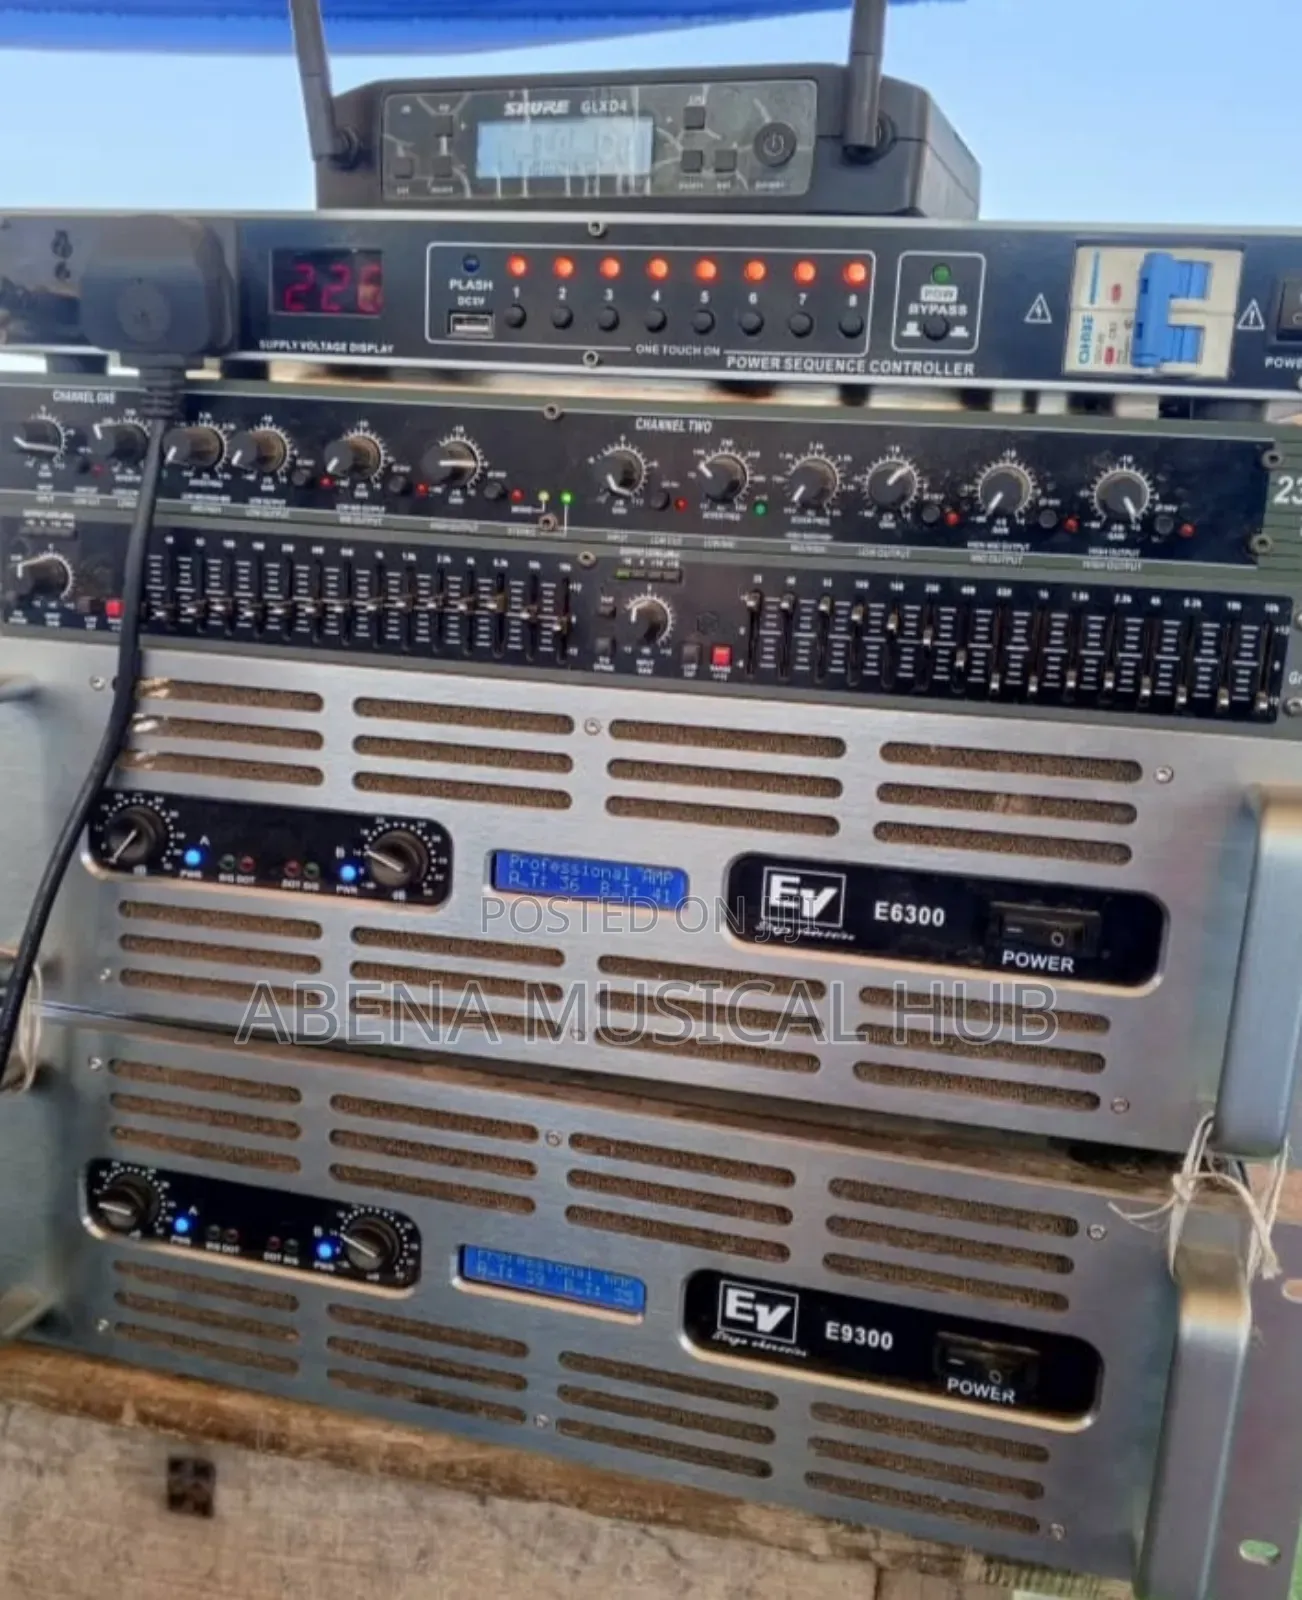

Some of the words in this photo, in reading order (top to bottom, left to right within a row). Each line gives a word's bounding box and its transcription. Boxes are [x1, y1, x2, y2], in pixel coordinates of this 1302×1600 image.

[504, 99, 569, 115] SHURE
[580, 100, 628, 114] GLXD4
[512, 286, 520, 298] 1
[558, 287, 567, 300] 2
[605, 288, 613, 301] 3
[651, 289, 660, 302] 4
[799, 292, 808, 306] 7
[908, 303, 967, 317] BYPASS
[259, 339, 298, 351] SUPPLY
[299, 341, 348, 354] VOLTAGE
[349, 343, 394, 355] DISPLAY
[635, 344, 659, 355] ONE
[660, 345, 701, 357] TOUCH
[702, 346, 721, 357] ON
[726, 355, 781, 370] POWER
[783, 357, 866, 373] SEQUENCE
[868, 359, 975, 376] CONTROLLER
[635, 417, 686, 432] CHANNEL
[688, 419, 713, 434] TWO
[200, 835, 210, 846] A
[509, 852, 629, 882] Professional
[768, 874, 838, 919] EV
[873, 900, 946, 928] E6300
[1001, 949, 1075, 974] POWER
[188, 1205, 198, 1216] A
[725, 1287, 793, 1333] EV
[825, 1321, 894, 1351] E9300
[947, 1376, 1016, 1405] POWER
